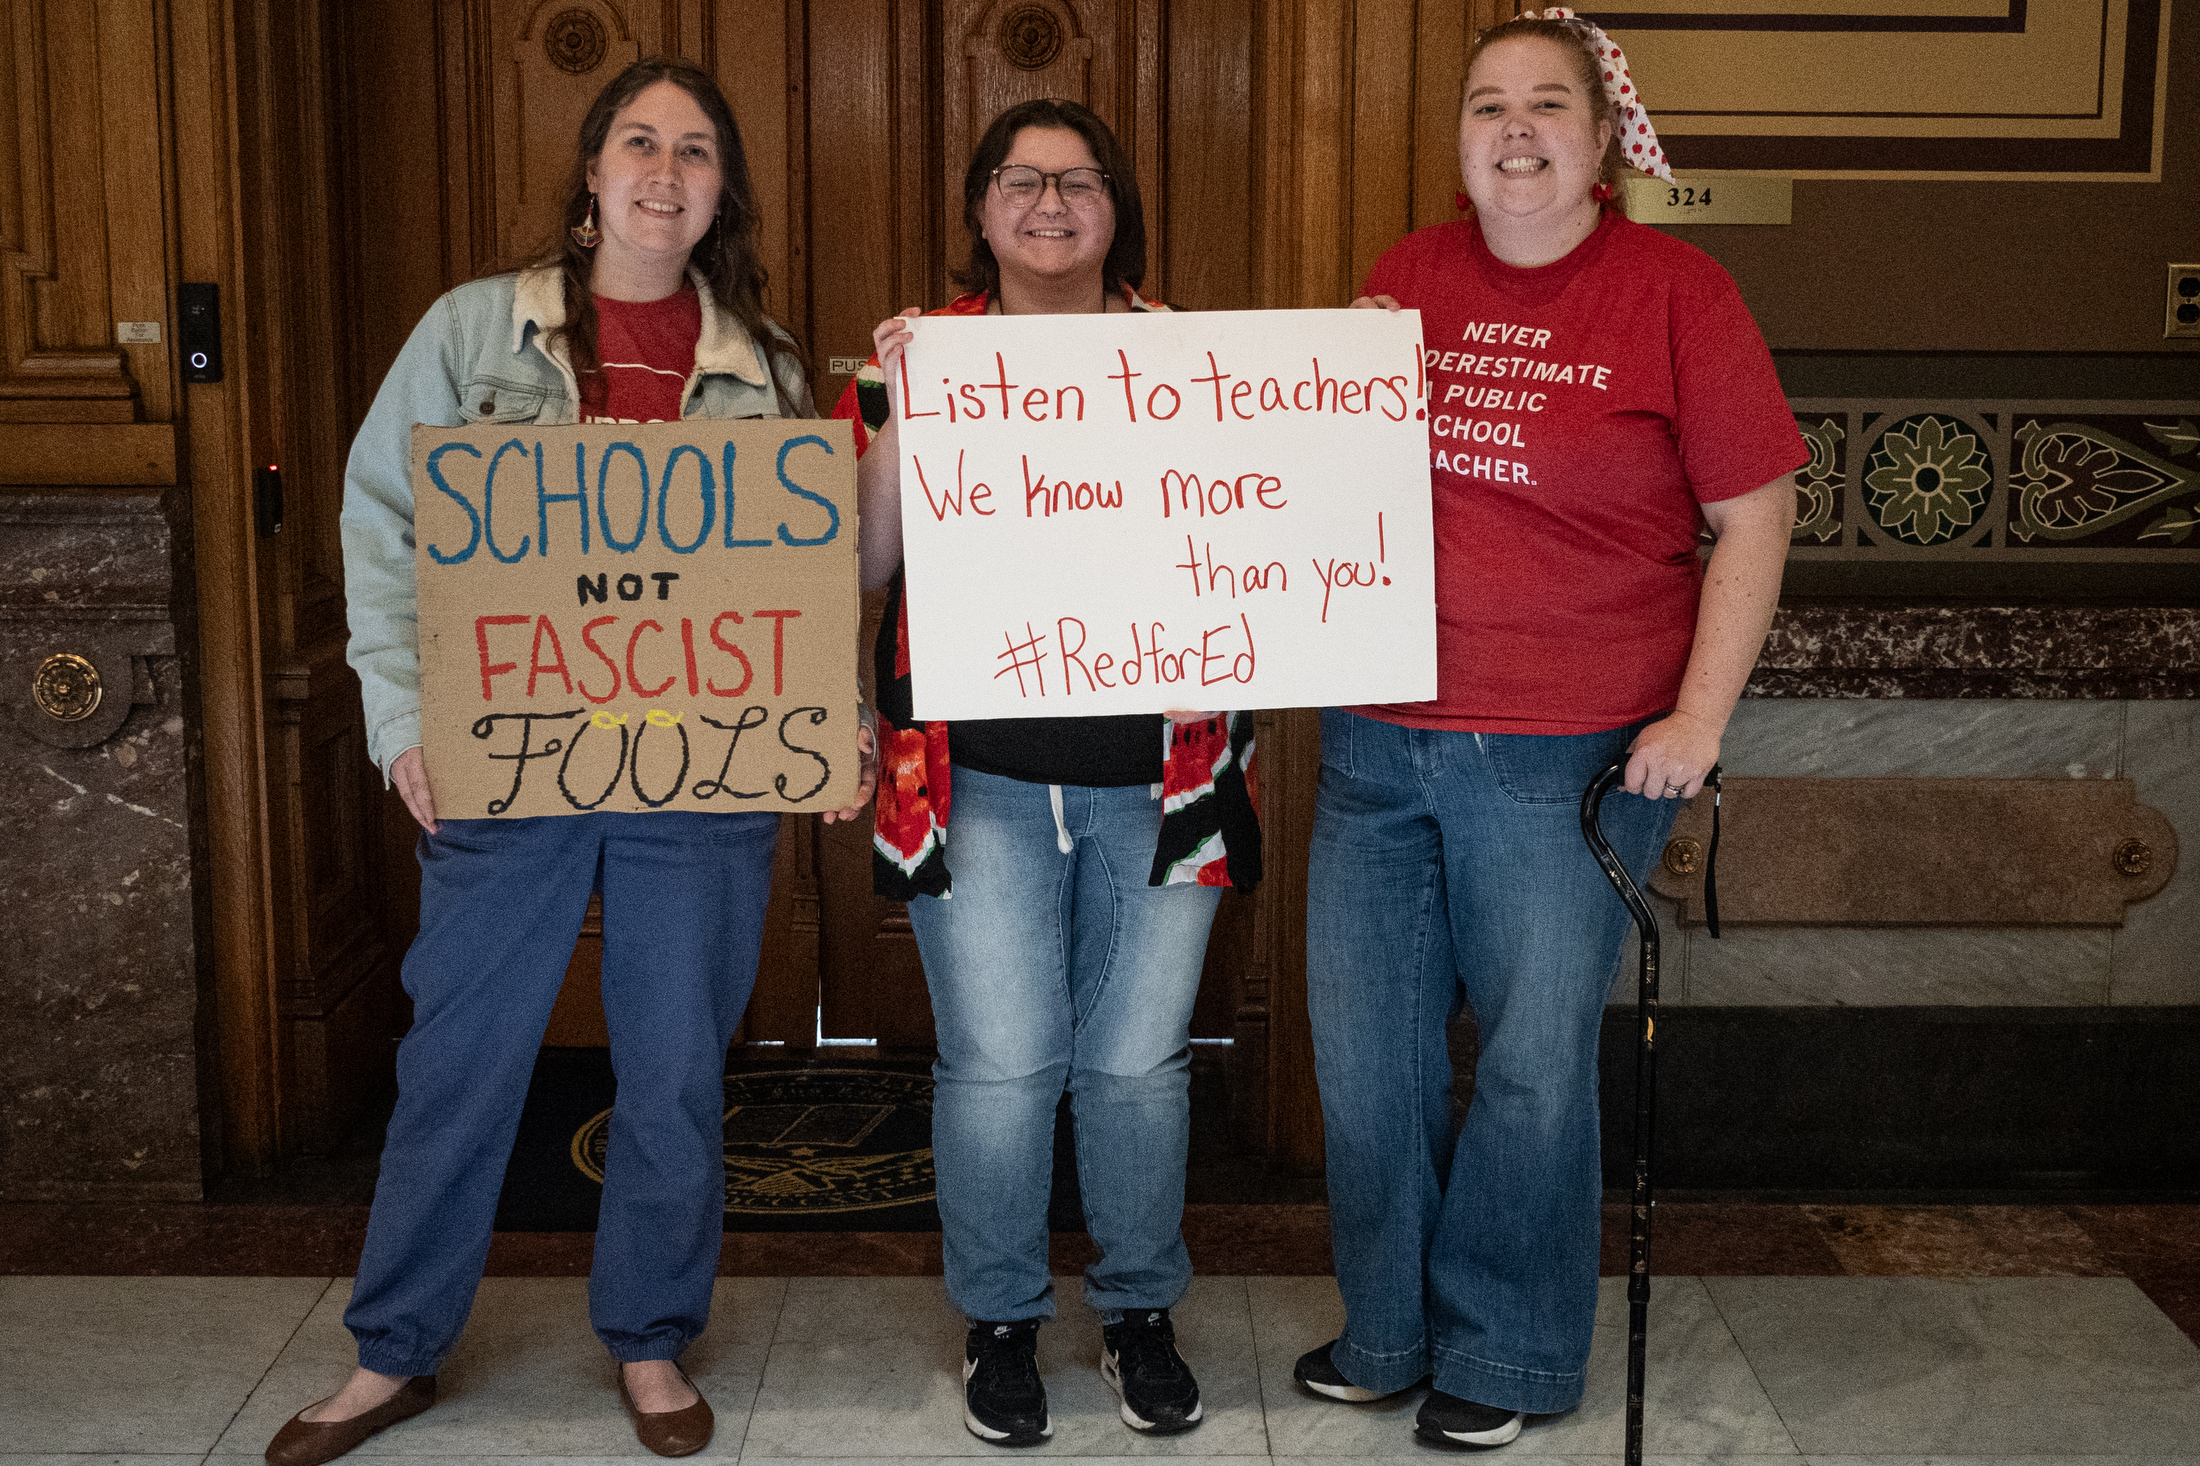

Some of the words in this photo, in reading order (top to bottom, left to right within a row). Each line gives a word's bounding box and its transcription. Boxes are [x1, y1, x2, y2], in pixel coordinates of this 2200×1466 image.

[1667, 188, 1712, 207] 324
[1462, 321, 1552, 349] NEVER
[900, 345, 1085, 423] Listen
[1107, 349, 1181, 423] to
[1190, 343, 1427, 423] teachers!
[1444, 384, 1547, 412] PUBLIC
[1429, 413, 1526, 448] CHOOL
[426, 434, 841, 565] SCHOOLS
[914, 449, 996, 521] We
[1022, 455, 1122, 518] know
[1430, 449, 1538, 486] ACHER.
[577, 572, 680, 606] NOT
[1176, 535, 1287, 598] than
[1312, 512, 1392, 623] you!
[474, 610, 802, 704] FASCIST
[994, 612, 1256, 698] #RedforEd
[472, 706, 831, 815] FOOLS
